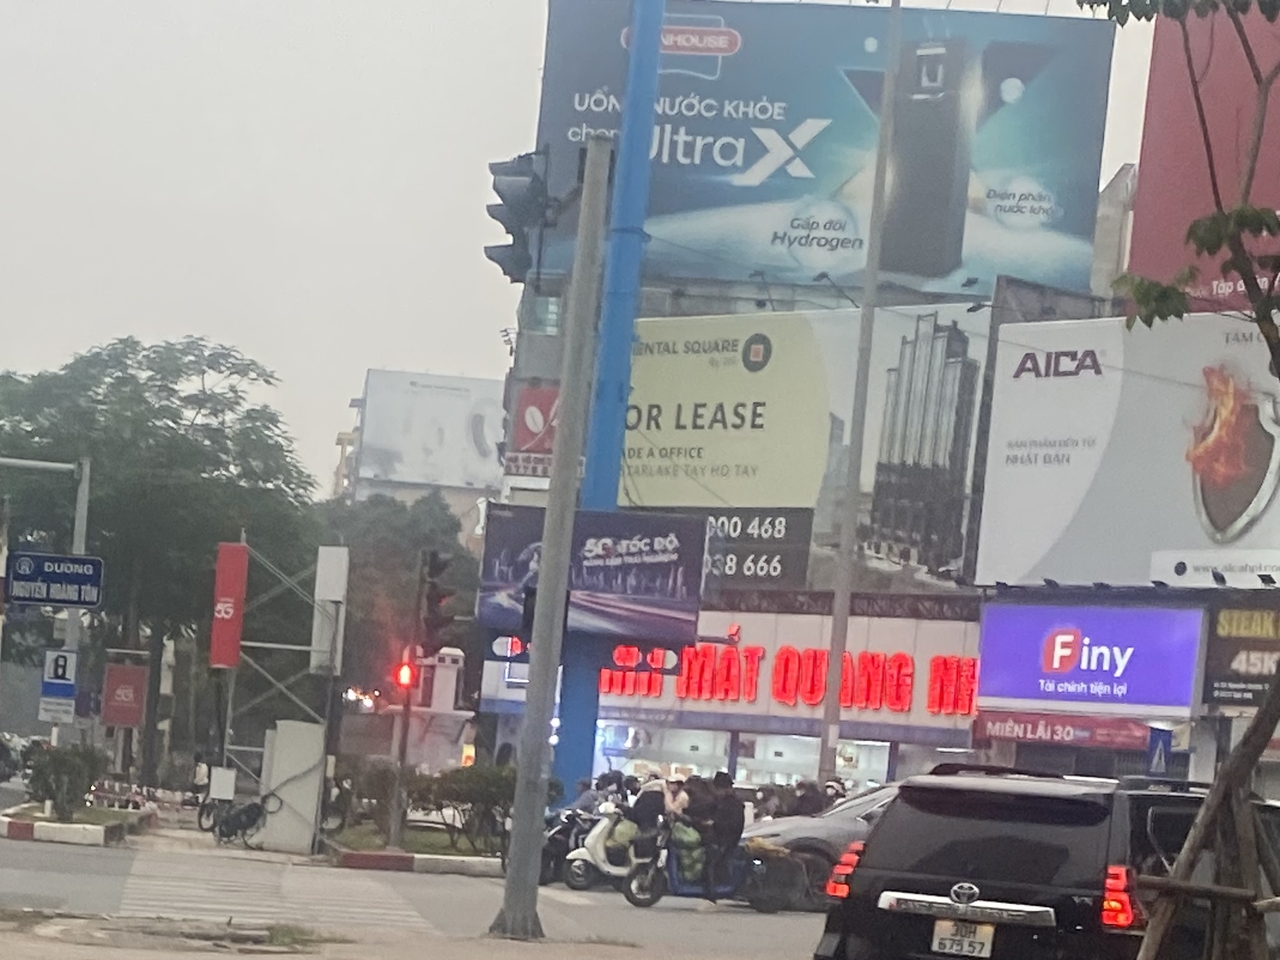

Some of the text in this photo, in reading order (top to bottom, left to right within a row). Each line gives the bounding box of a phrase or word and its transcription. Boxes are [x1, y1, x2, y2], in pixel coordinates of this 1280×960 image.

[660, 34, 730, 48] NHOUSE
[574, 86, 620, 112] UỐN
[723, 95, 786, 120] KHỎE
[568, 123, 619, 142] ch
[771, 231, 864, 251] Hydrogen
[683, 338, 740, 354] SQUARE
[1013, 350, 1103, 378] AICA
[625, 401, 767, 431] OR LEASE
[659, 446, 704, 459] OFFICE
[627, 464, 679, 477] TARLAKE
[746, 516, 787, 538] 468
[743, 555, 782, 577] 666
[1051, 634, 1135, 677] Finy
[1053, 726, 1074, 741] 30
